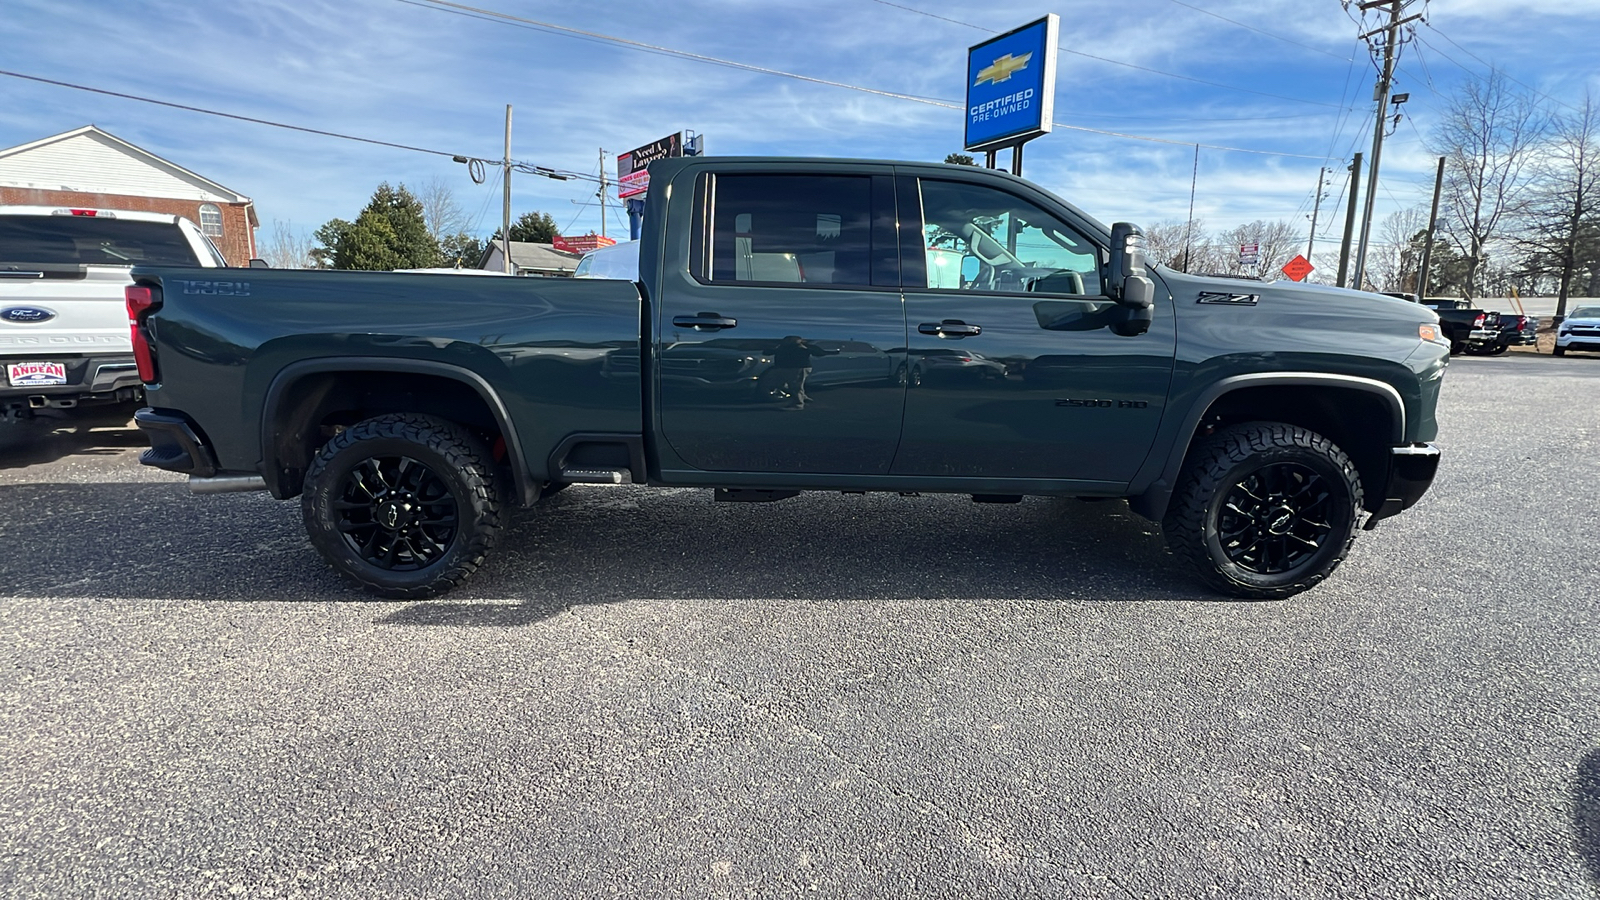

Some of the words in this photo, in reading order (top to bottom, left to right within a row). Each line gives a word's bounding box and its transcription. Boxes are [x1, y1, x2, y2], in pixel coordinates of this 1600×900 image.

[970, 88, 1034, 116] CERTIFIED
[972, 100, 1030, 124] PRE-OWNED
[635, 144, 655, 158] Need
[10, 310, 41, 320] Ford
[12, 365, 64, 379] ANDEAN
